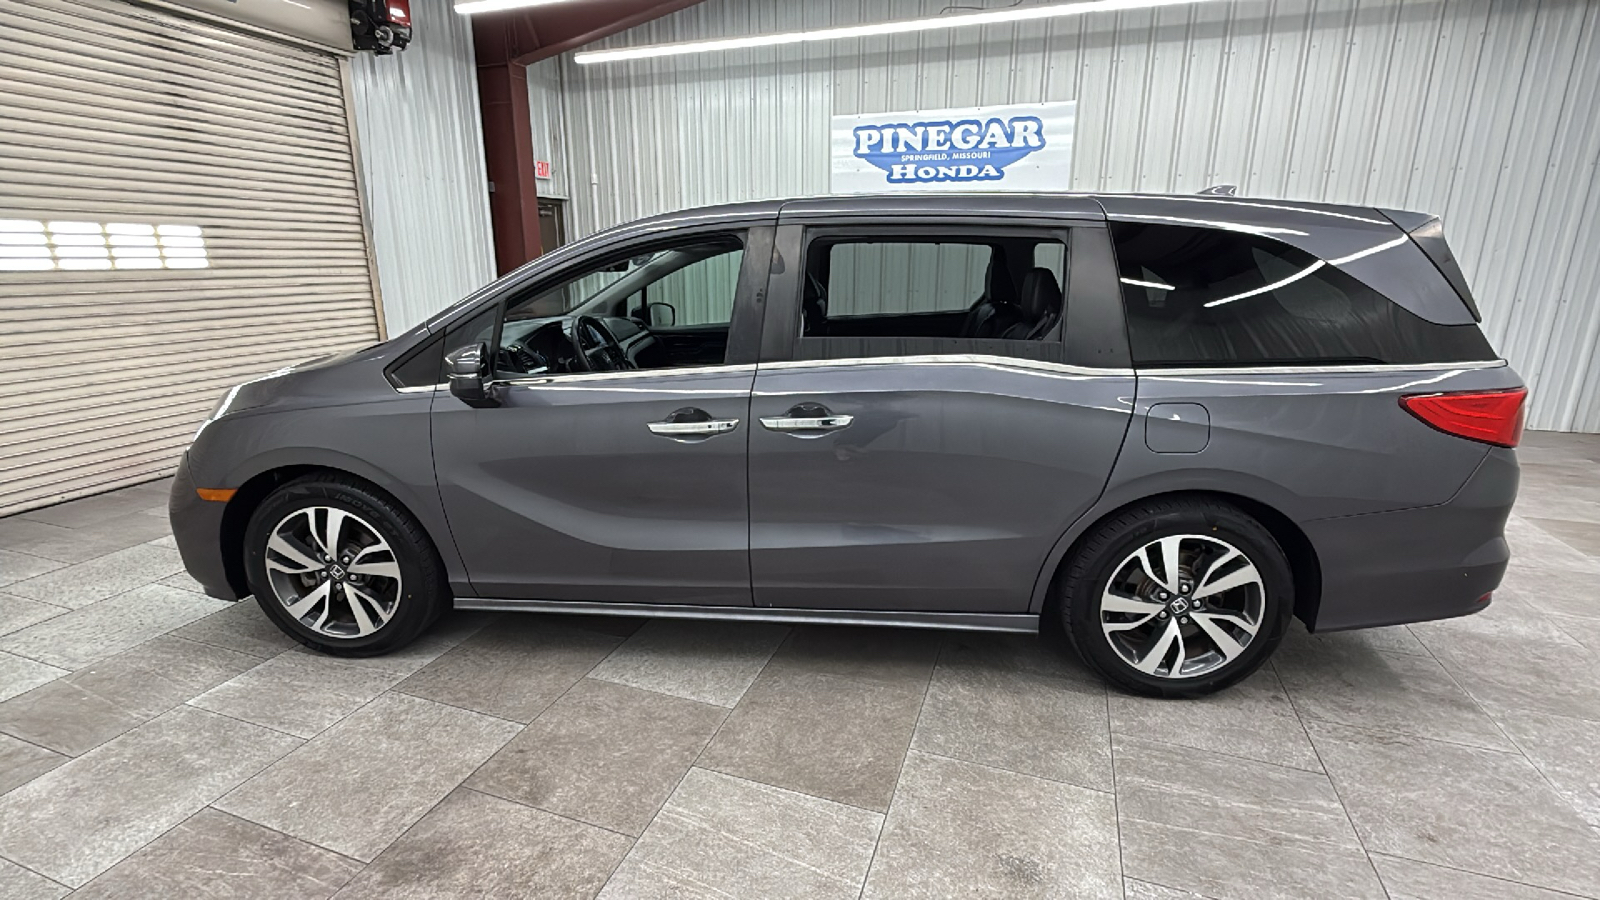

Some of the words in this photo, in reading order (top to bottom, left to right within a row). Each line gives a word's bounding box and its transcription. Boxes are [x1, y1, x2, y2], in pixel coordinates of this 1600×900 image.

[856, 120, 1042, 154] PINEGAR
[901, 153, 950, 162] SPRINGFIELD,
[952, 151, 991, 160] MISSOURI
[537, 161, 549, 177] EXIT
[890, 164, 1000, 180] HONDA
